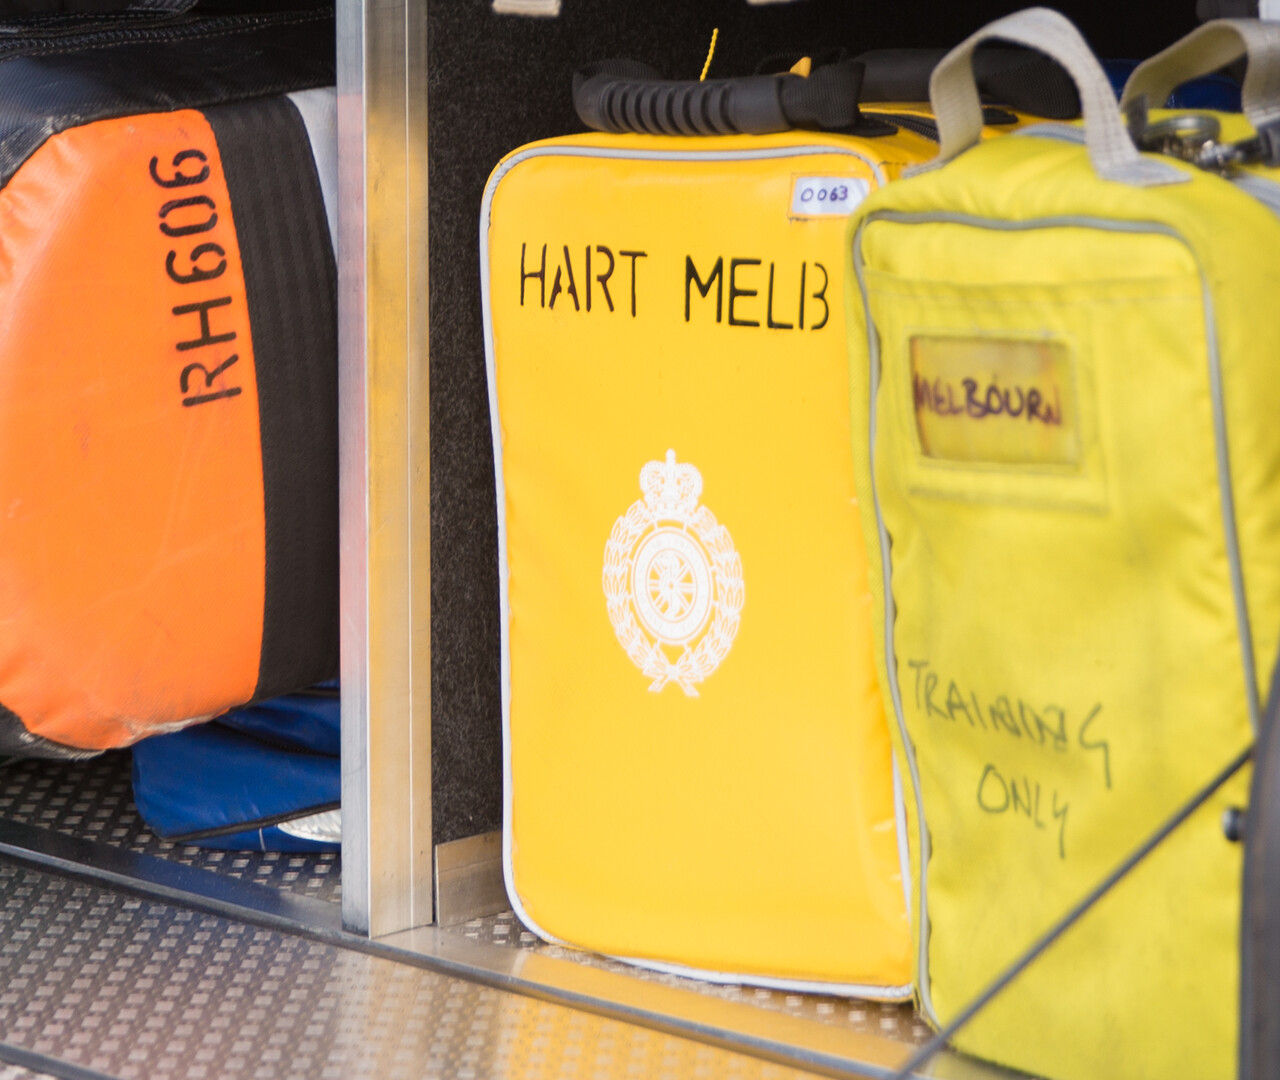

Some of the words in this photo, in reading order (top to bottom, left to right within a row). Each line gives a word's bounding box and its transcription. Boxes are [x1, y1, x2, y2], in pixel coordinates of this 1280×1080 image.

[800, 185, 849, 203] 0063
[149, 148, 242, 407] RH606
[520, 242, 648, 318] HART
[684, 255, 830, 331] MELB
[977, 762, 1070, 860] ONLY
